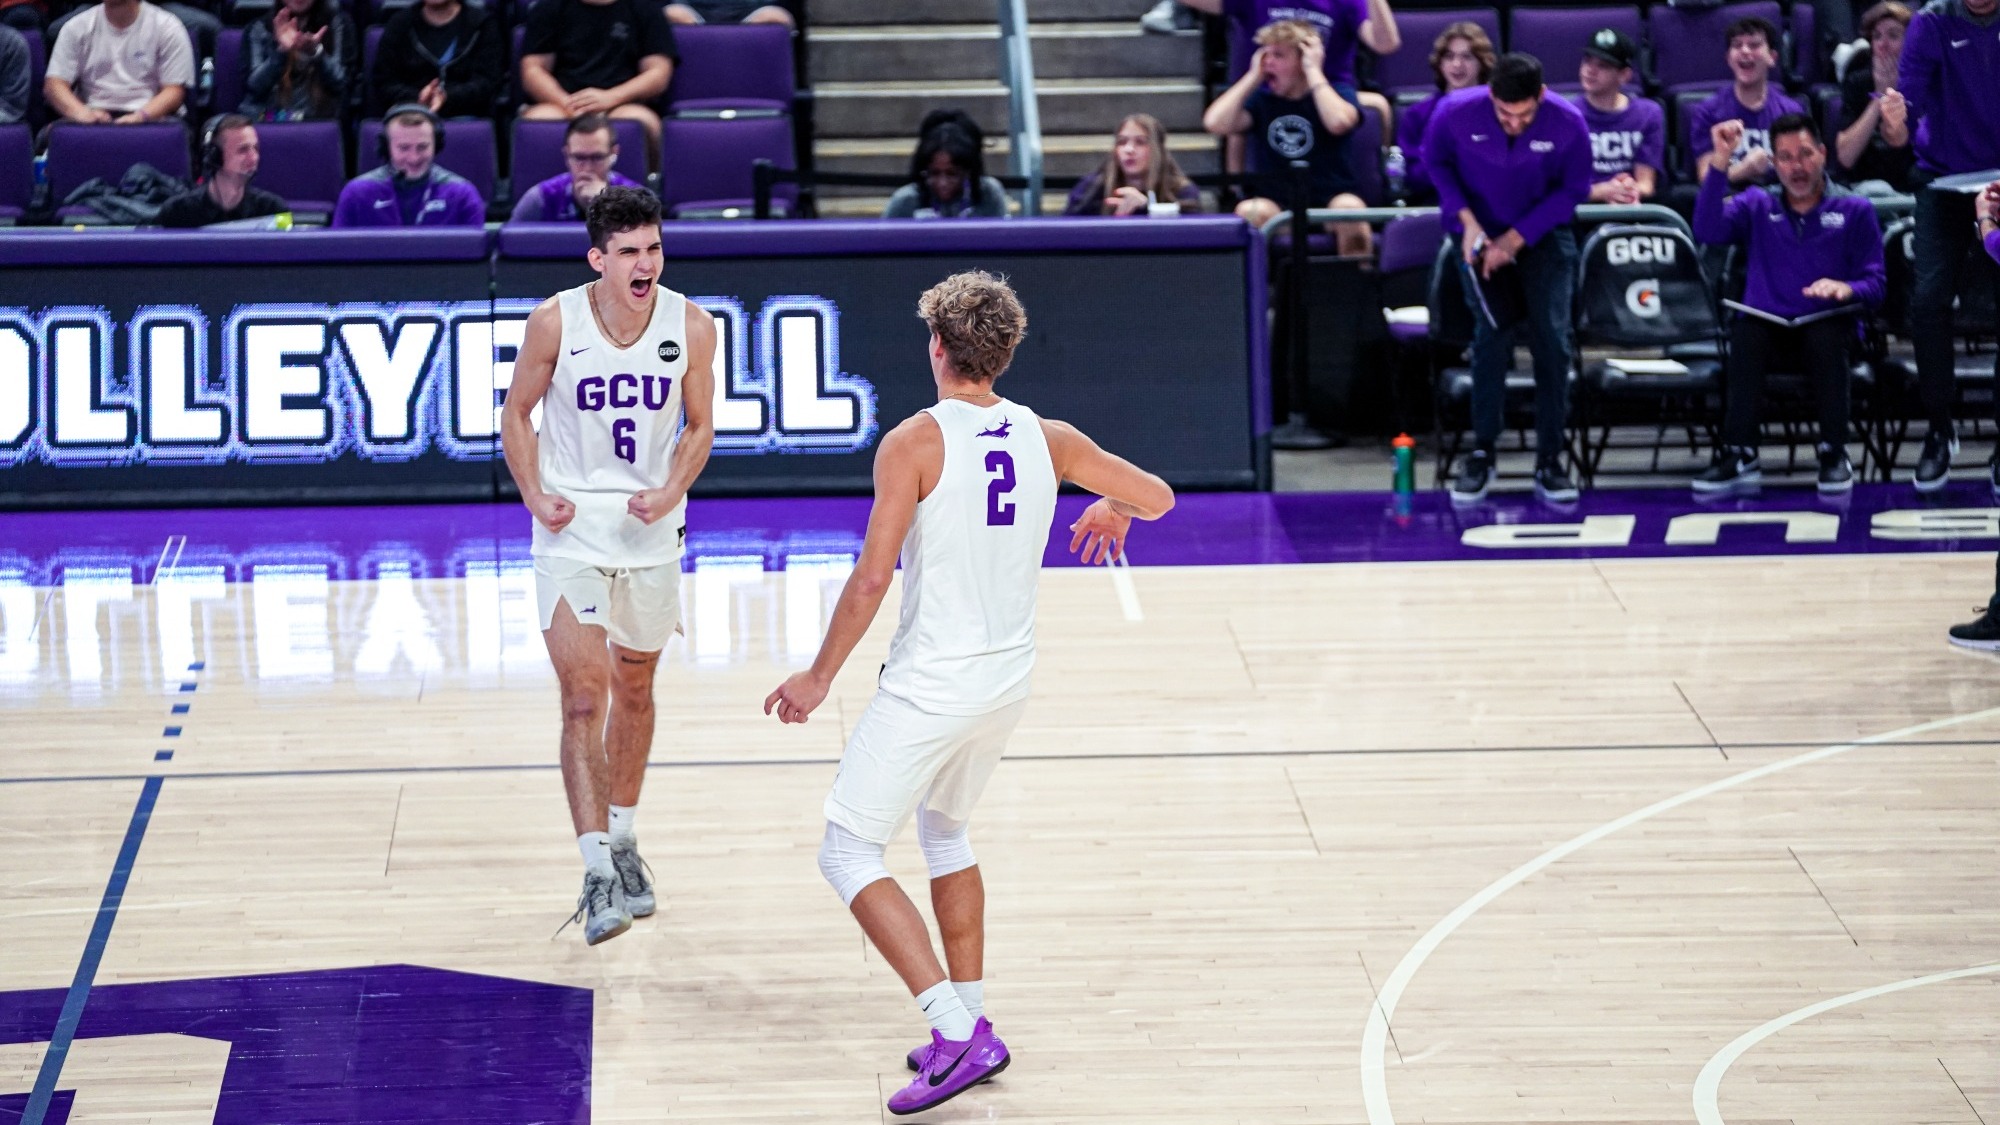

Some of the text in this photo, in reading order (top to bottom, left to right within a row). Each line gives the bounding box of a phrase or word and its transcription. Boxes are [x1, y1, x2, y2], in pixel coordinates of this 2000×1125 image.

[1607, 236, 1676, 266] GCU
[1625, 278, 1661, 318] G
[576, 373, 672, 411] GCU
[612, 418, 636, 464] 6
[984, 450, 1017, 526] 2
